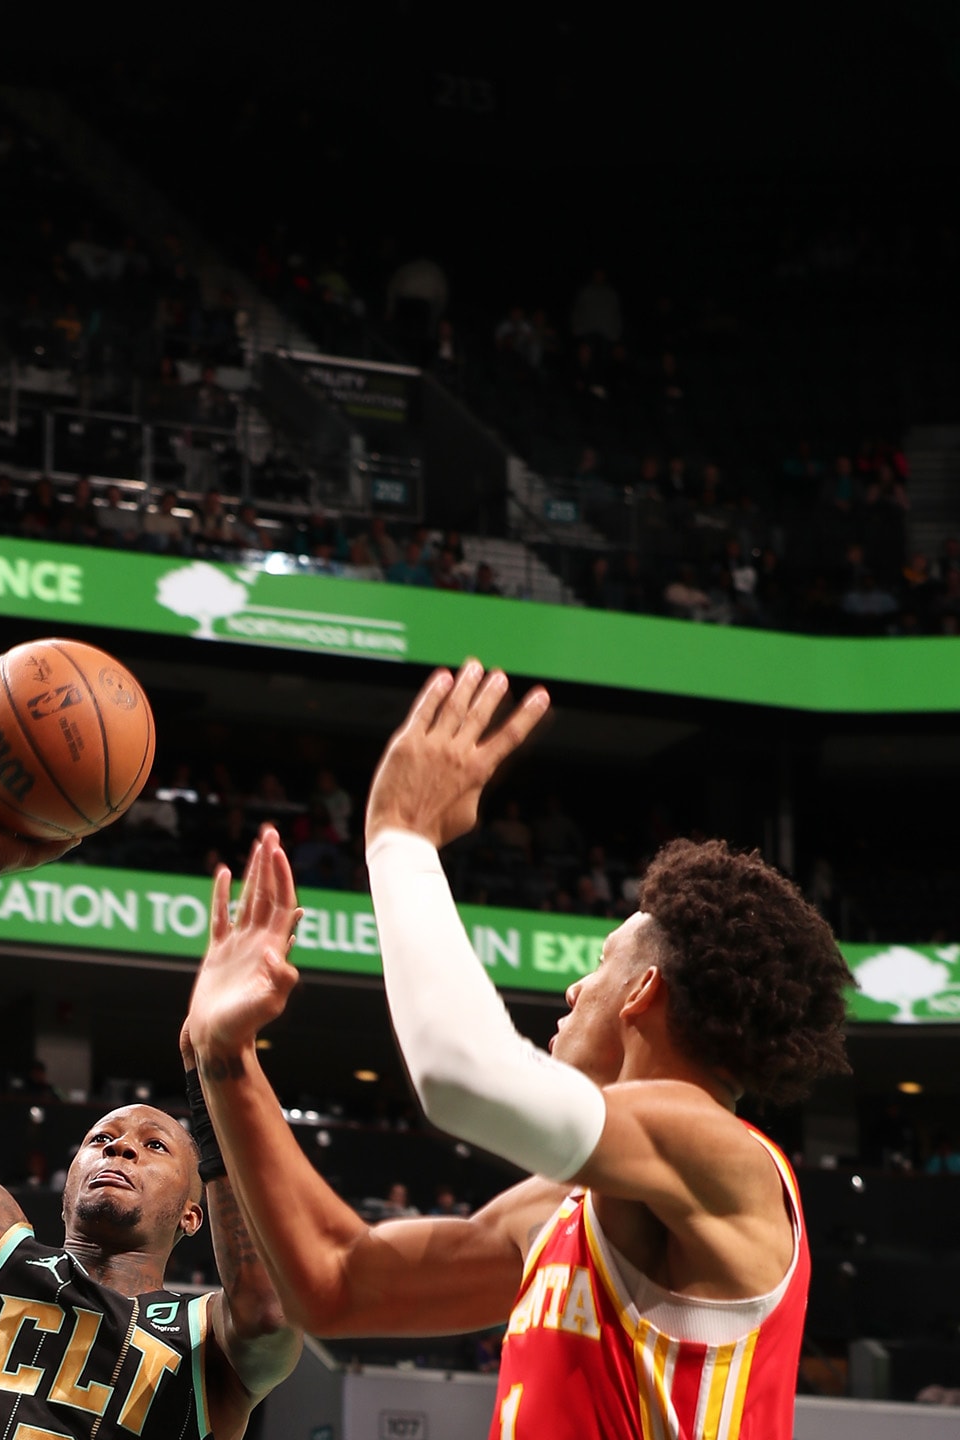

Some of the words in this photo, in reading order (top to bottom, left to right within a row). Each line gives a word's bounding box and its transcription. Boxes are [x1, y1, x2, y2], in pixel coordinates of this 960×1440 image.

[146, 891, 208, 937] TO
[472, 923, 521, 969] IN
[387, 1417, 421, 1437] 107
